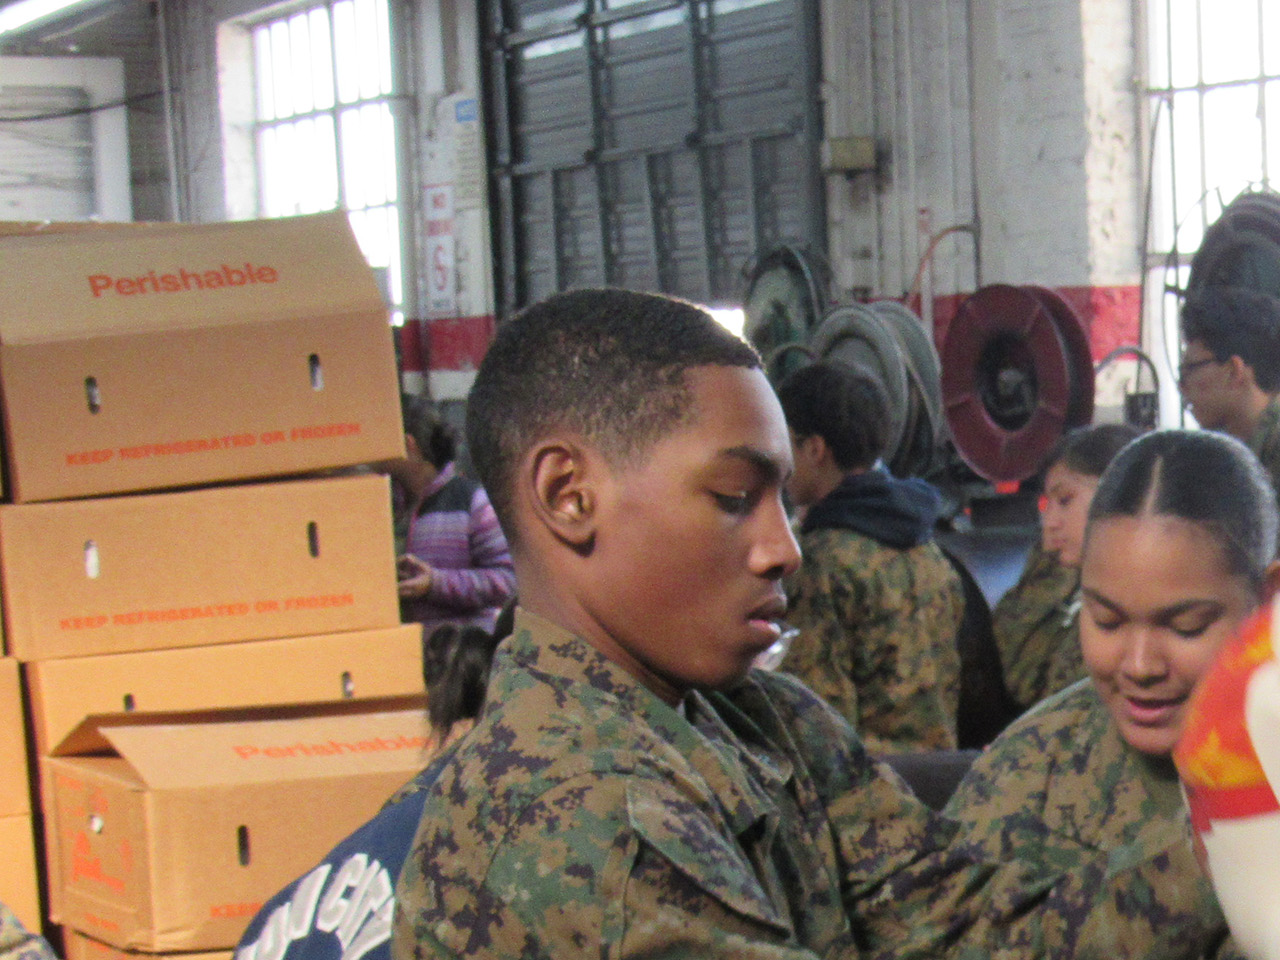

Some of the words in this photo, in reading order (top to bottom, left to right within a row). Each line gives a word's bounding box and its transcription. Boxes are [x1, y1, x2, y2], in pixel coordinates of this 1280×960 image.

[88, 262, 279, 297] Perishable
[66, 449, 113, 466] KEEP
[119, 433, 256, 460] REFRIGERATED
[260, 430, 287, 445] OR
[59, 615, 109, 630] KEEP
[112, 602, 250, 626] REFRIGERATED
[254, 600, 280, 613] OR
